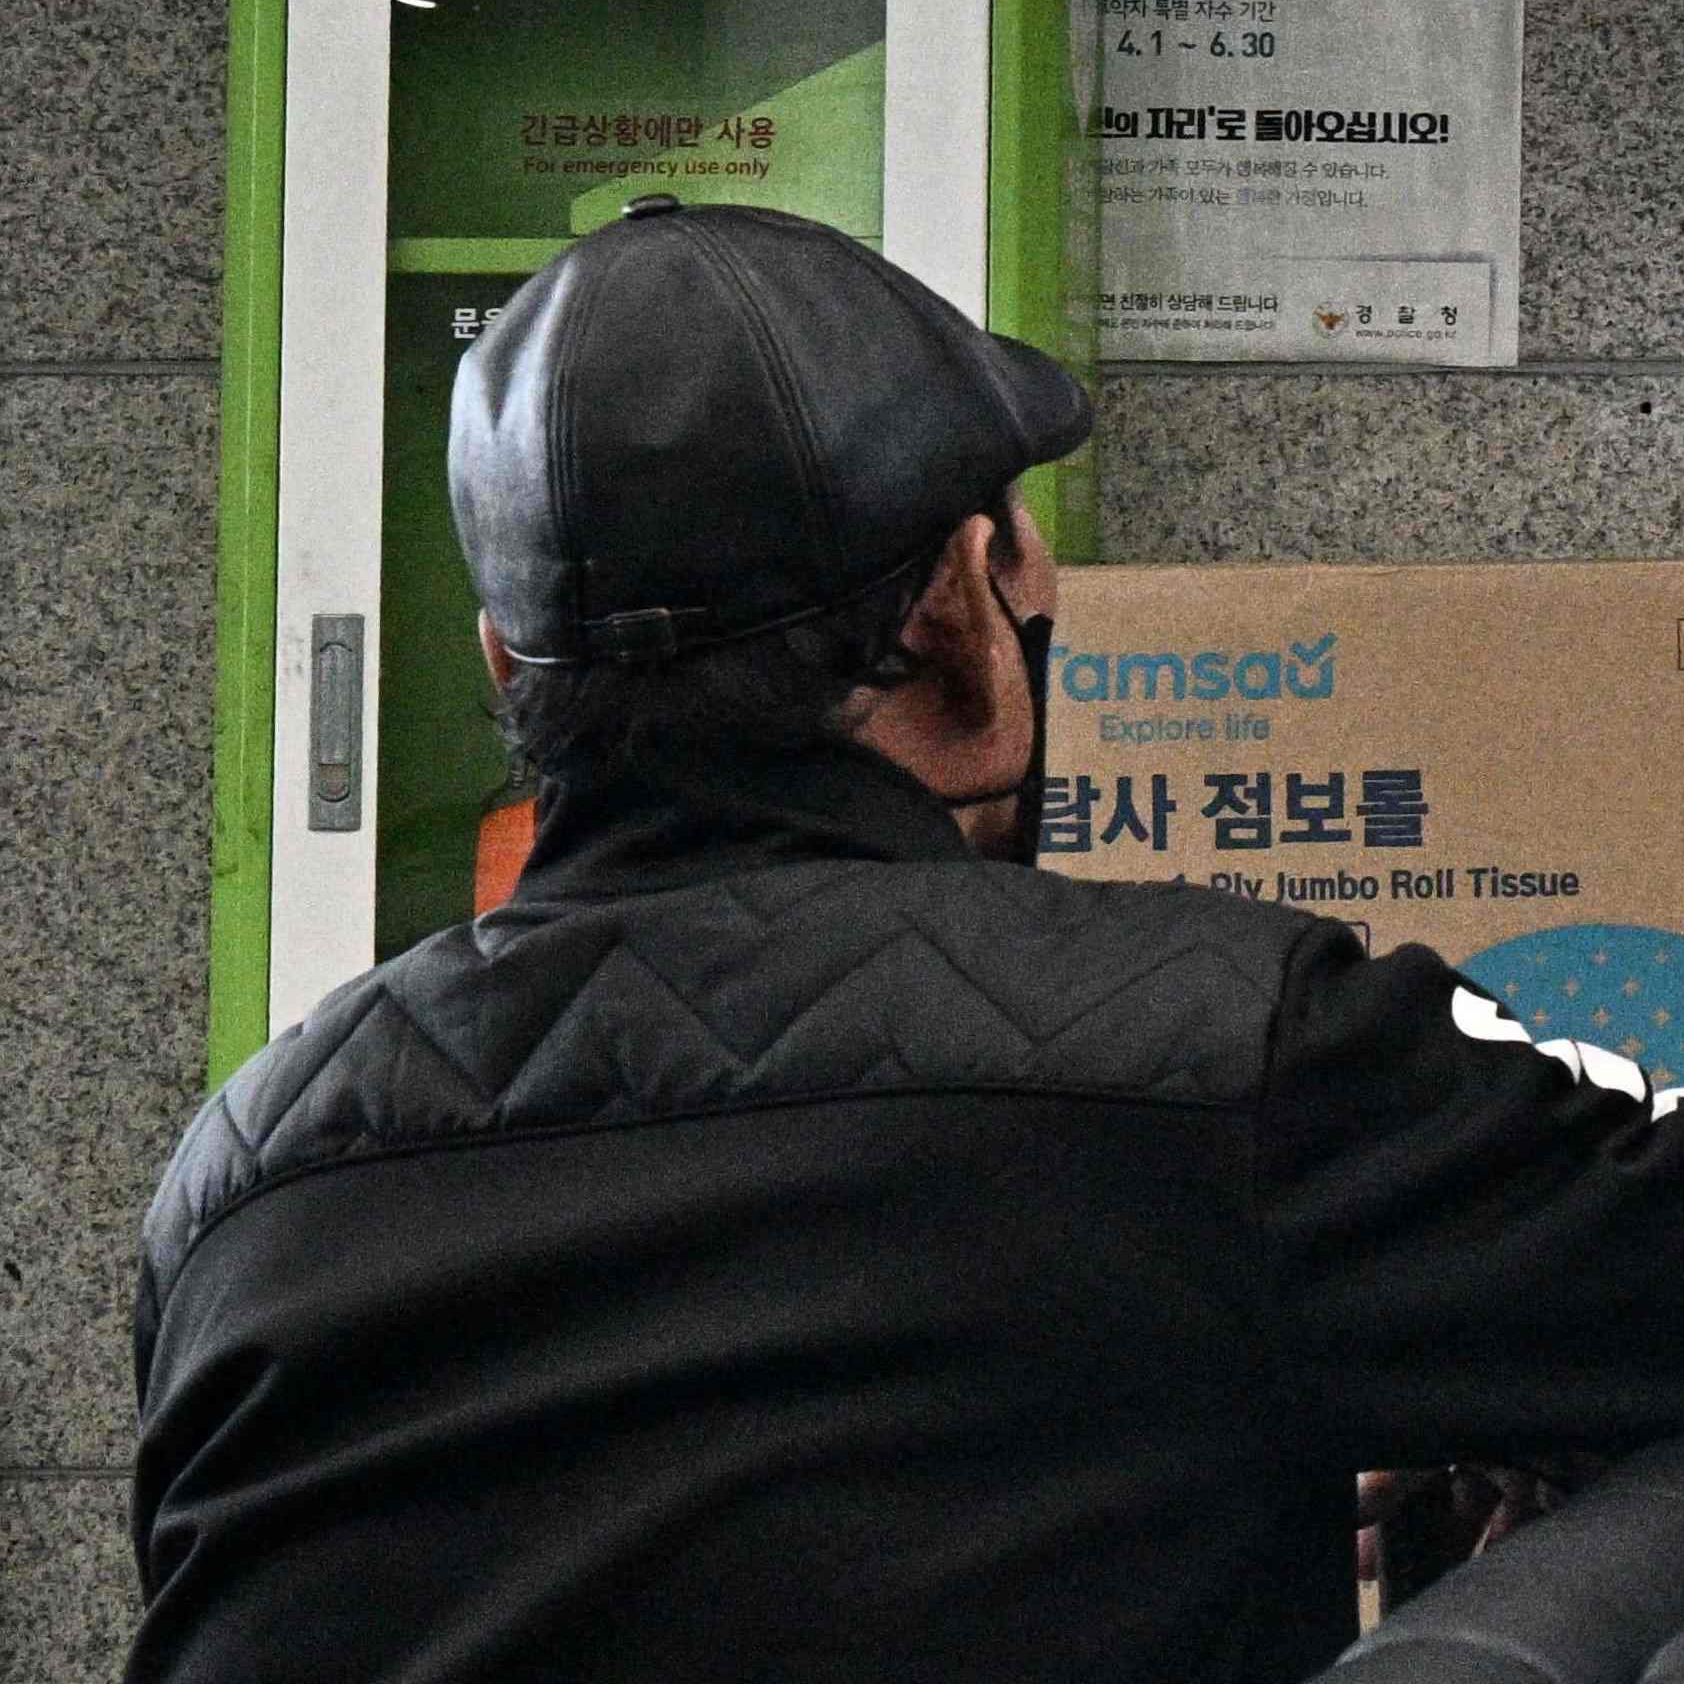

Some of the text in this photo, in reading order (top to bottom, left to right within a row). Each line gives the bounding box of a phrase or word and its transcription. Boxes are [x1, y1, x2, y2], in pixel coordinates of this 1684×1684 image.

[1153, 0, 1188, 20] 특별
[1195, 0, 1232, 20] 자수
[1240, 0, 1277, 23] 기간
[1117, 29, 1163, 57] 4.1
[1210, 31, 1276, 58] 6.30
[520, 115, 777, 149] 긴급상황에만 사용
[1255, 109, 1450, 144] 돌아오십시오!
[523, 157, 771, 180] For emergency use only
[1149, 158, 1180, 178] 가족
[1185, 159, 1233, 179] 모두가
[1302, 160, 1319, 178] 수
[1200, 188, 1232, 206] 있는
[1120, 294, 1164, 312] 친절히
[1167, 294, 1214, 312] 상담해
[1217, 295, 1279, 314] 드립니다
[1101, 714, 1271, 745] Explore life
[1038, 769, 1430, 854] 탐사 점보롤
[1276, 869, 1379, 902] Jumbo
[1390, 867, 1455, 900] Roll
[1466, 865, 1581, 899] Tissue
